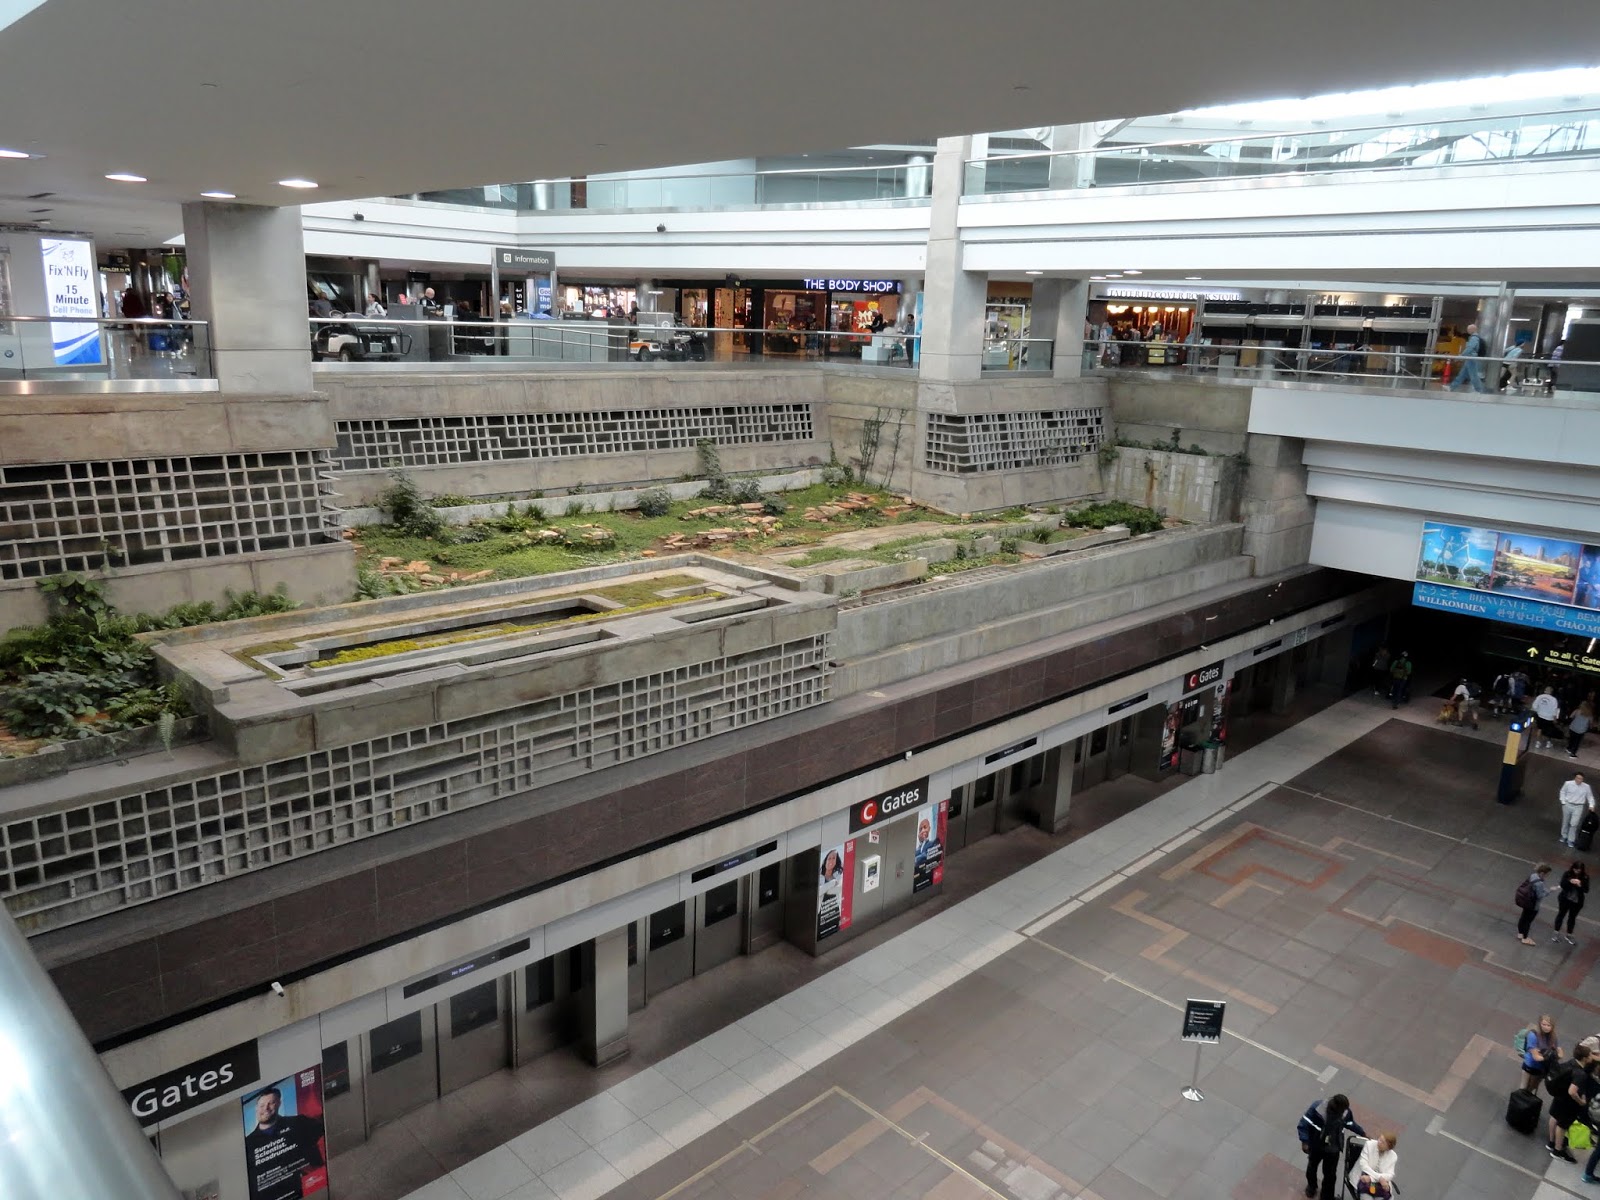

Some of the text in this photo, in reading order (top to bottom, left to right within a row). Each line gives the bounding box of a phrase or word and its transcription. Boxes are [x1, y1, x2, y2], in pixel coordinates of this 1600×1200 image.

[514, 255, 549, 264] Information
[74, 266, 89, 280] Fly
[66, 285, 78, 295] 15
[804, 279, 825, 290] THE
[829, 280, 860, 291] BODY
[863, 281, 893, 292] SHOP
[55, 294, 89, 305] Minute
[1108, 289, 1241, 301] TATTERED COVER BOK STORE
[52, 305, 93, 315] Cell Phone
[1418, 584, 1459, 599] ようこそ
[1418, 595, 1487, 613] WILLKOMMEN
[1469, 593, 1529, 611] BIENVENUE
[1549, 650, 1559, 658] to
[1561, 652, 1571, 660] all
[1189, 667, 1219, 687] C Gates
[863, 803, 873, 820] C
[882, 788, 919, 813] Gates
[131, 1062, 234, 1117] Gates
[254, 1137, 286, 1154] Survivor.
[255, 1143, 287, 1160] Scientist.
[255, 1144, 298, 1166] Roadrunner.
